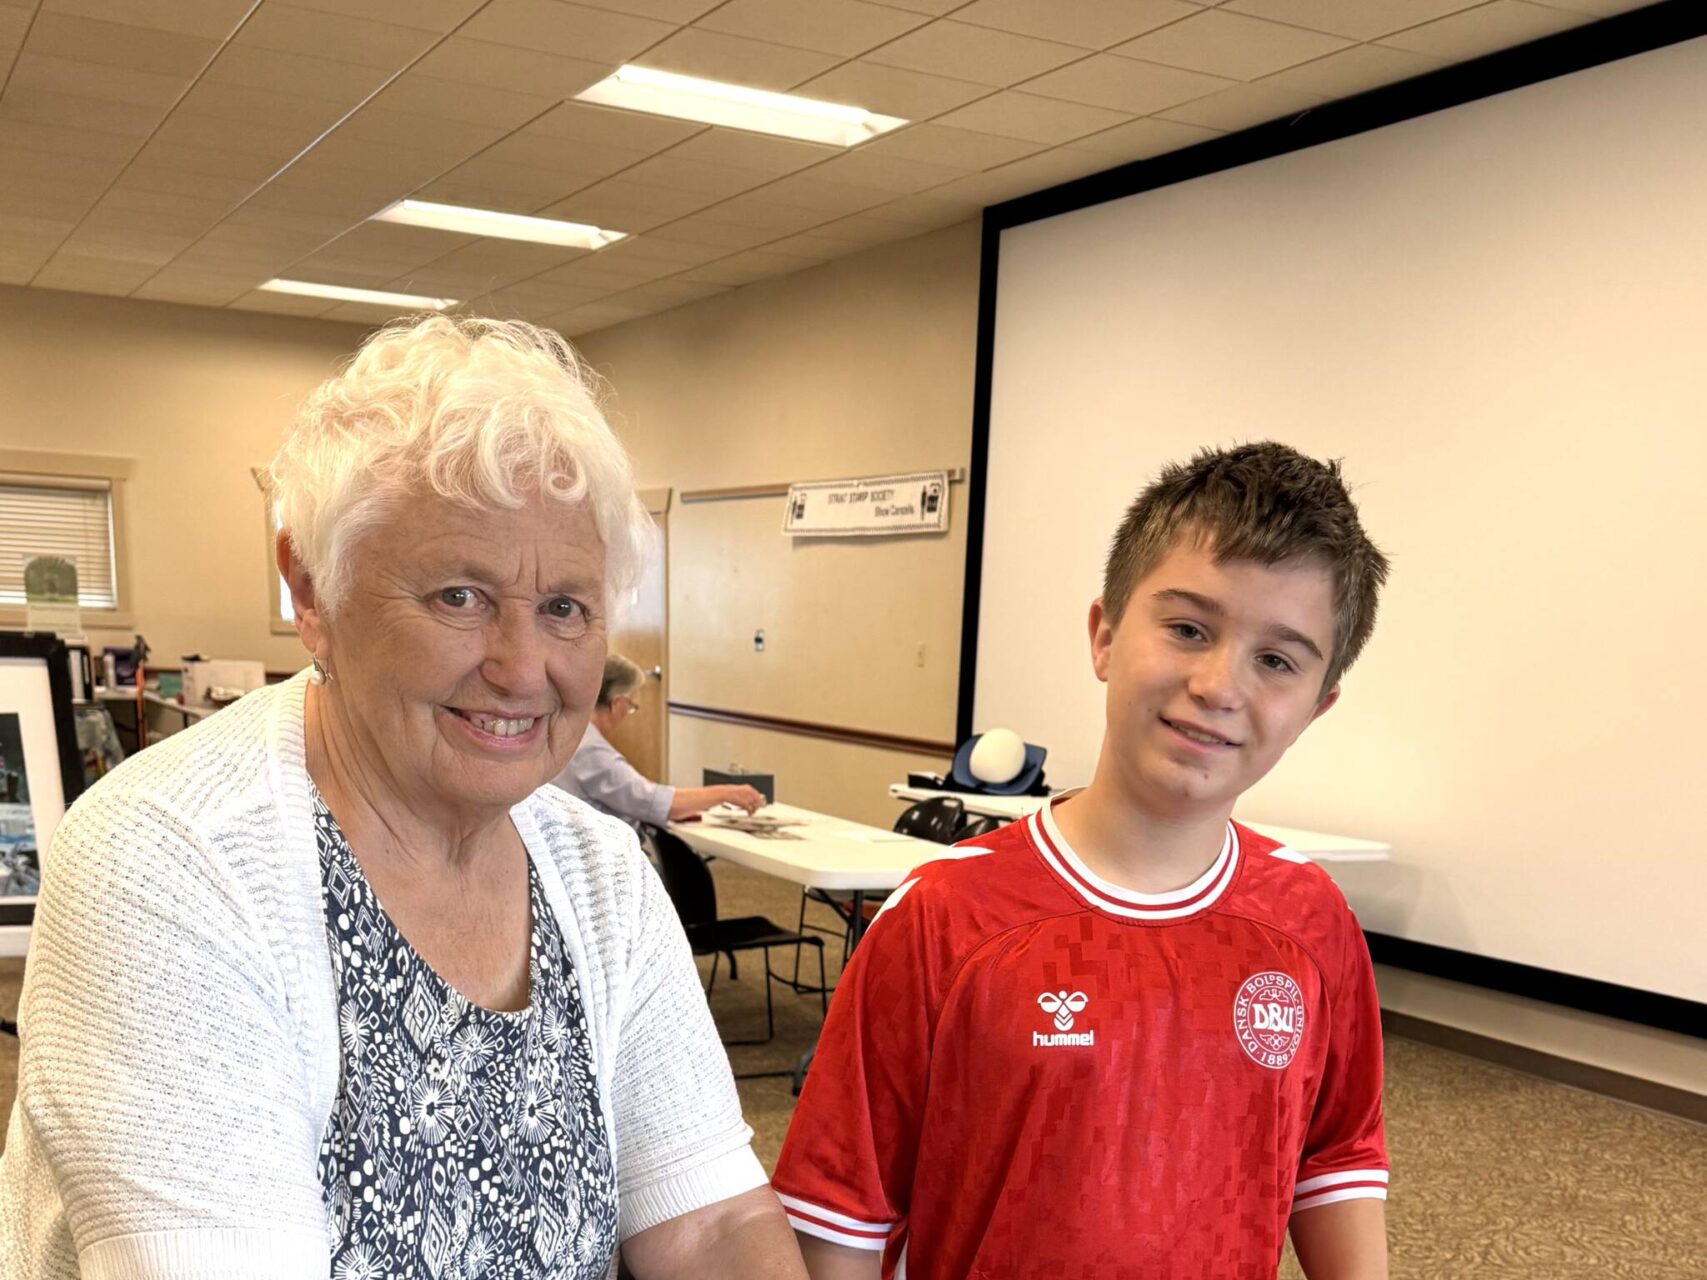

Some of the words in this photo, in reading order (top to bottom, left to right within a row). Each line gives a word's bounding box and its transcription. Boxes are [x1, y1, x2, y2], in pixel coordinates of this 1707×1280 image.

[1252, 1003, 1294, 1033] DBU
[1032, 1030, 1094, 1047] hummel
[1260, 1052, 1288, 1065] 1889
